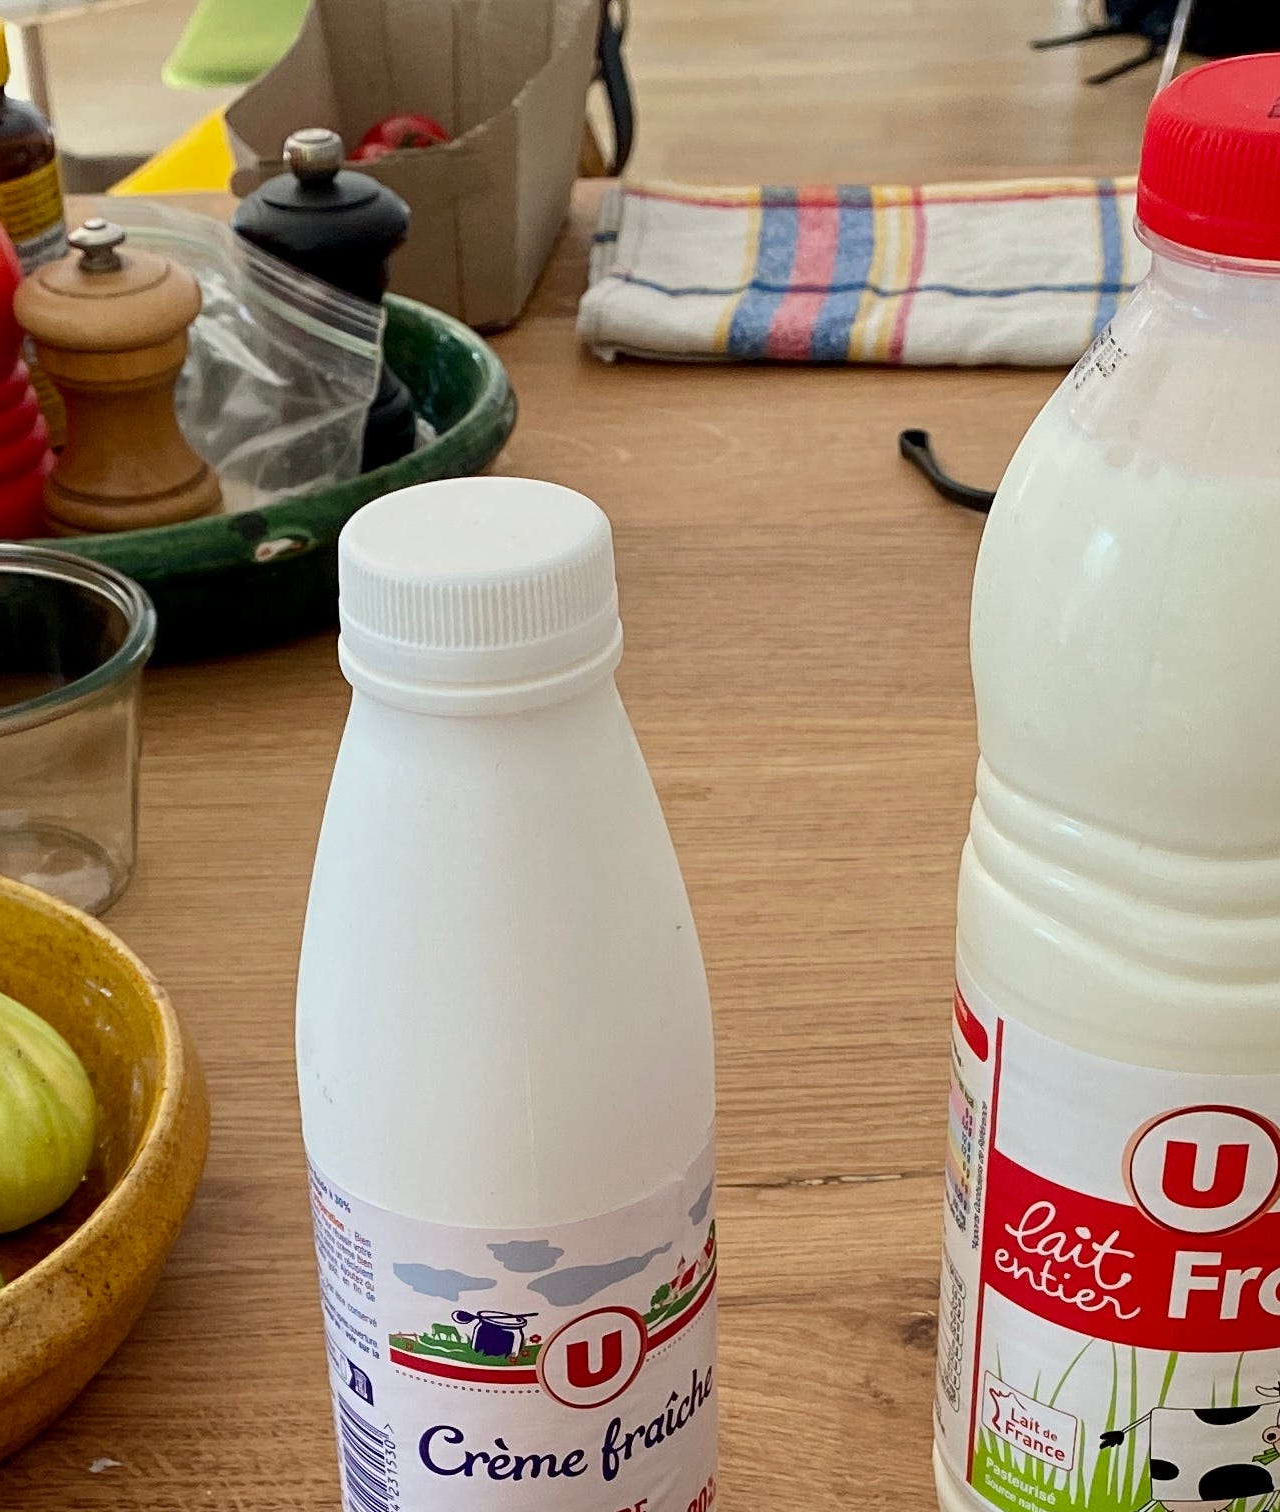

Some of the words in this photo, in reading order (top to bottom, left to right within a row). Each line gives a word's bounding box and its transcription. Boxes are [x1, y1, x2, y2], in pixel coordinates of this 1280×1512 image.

[1162, 1140, 1249, 1208] U
[1005, 1201, 1135, 1290] lait
[995, 1248, 1140, 1319] entier
[566, 1329, 622, 1388] U
[419, 1425, 588, 1481] Crème
[601, 1365, 714, 1481] fraîche
[1005, 1421, 1065, 1461] France
[1011, 1407, 1039, 1434] Lait
[1043, 1429, 1057, 1442] de
[985, 1474, 1016, 1502] Source
[986, 1457, 1056, 1505] Pasteurisé
